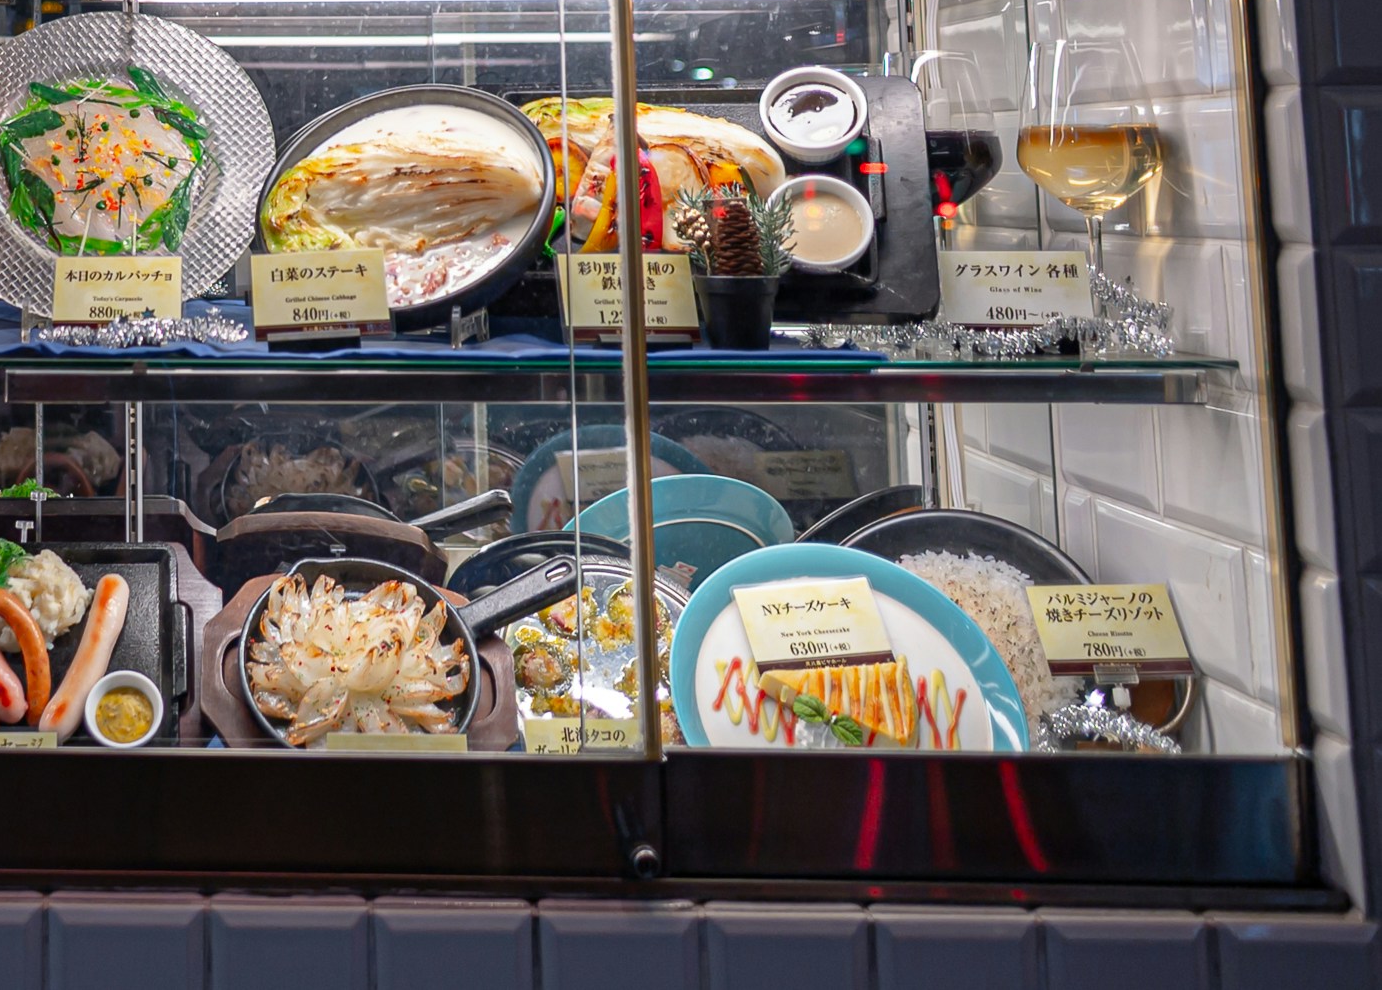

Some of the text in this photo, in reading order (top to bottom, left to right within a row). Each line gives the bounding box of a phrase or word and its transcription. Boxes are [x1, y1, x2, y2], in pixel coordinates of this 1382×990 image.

[65, 269, 173, 283] 本日のカルパッチョ
[270, 263, 368, 283] 白菜のステーキ
[955, 263, 1079, 279] グラスワイン 各種
[332, 294, 357, 302] Cabbage
[292, 307, 351, 322] 840円(+税)
[761, 597, 851, 617] NYチーズケーキ
[1047, 592, 1153, 606] パルミジャーノの
[1046, 606, 1164, 623] 焼きチーズリゾット
[796, 629, 812, 637] York
[813, 627, 850, 635] Cheesecake
[789, 641, 851, 657] 630円(+税)
[1083, 642, 1146, 658] 780円(+税)
